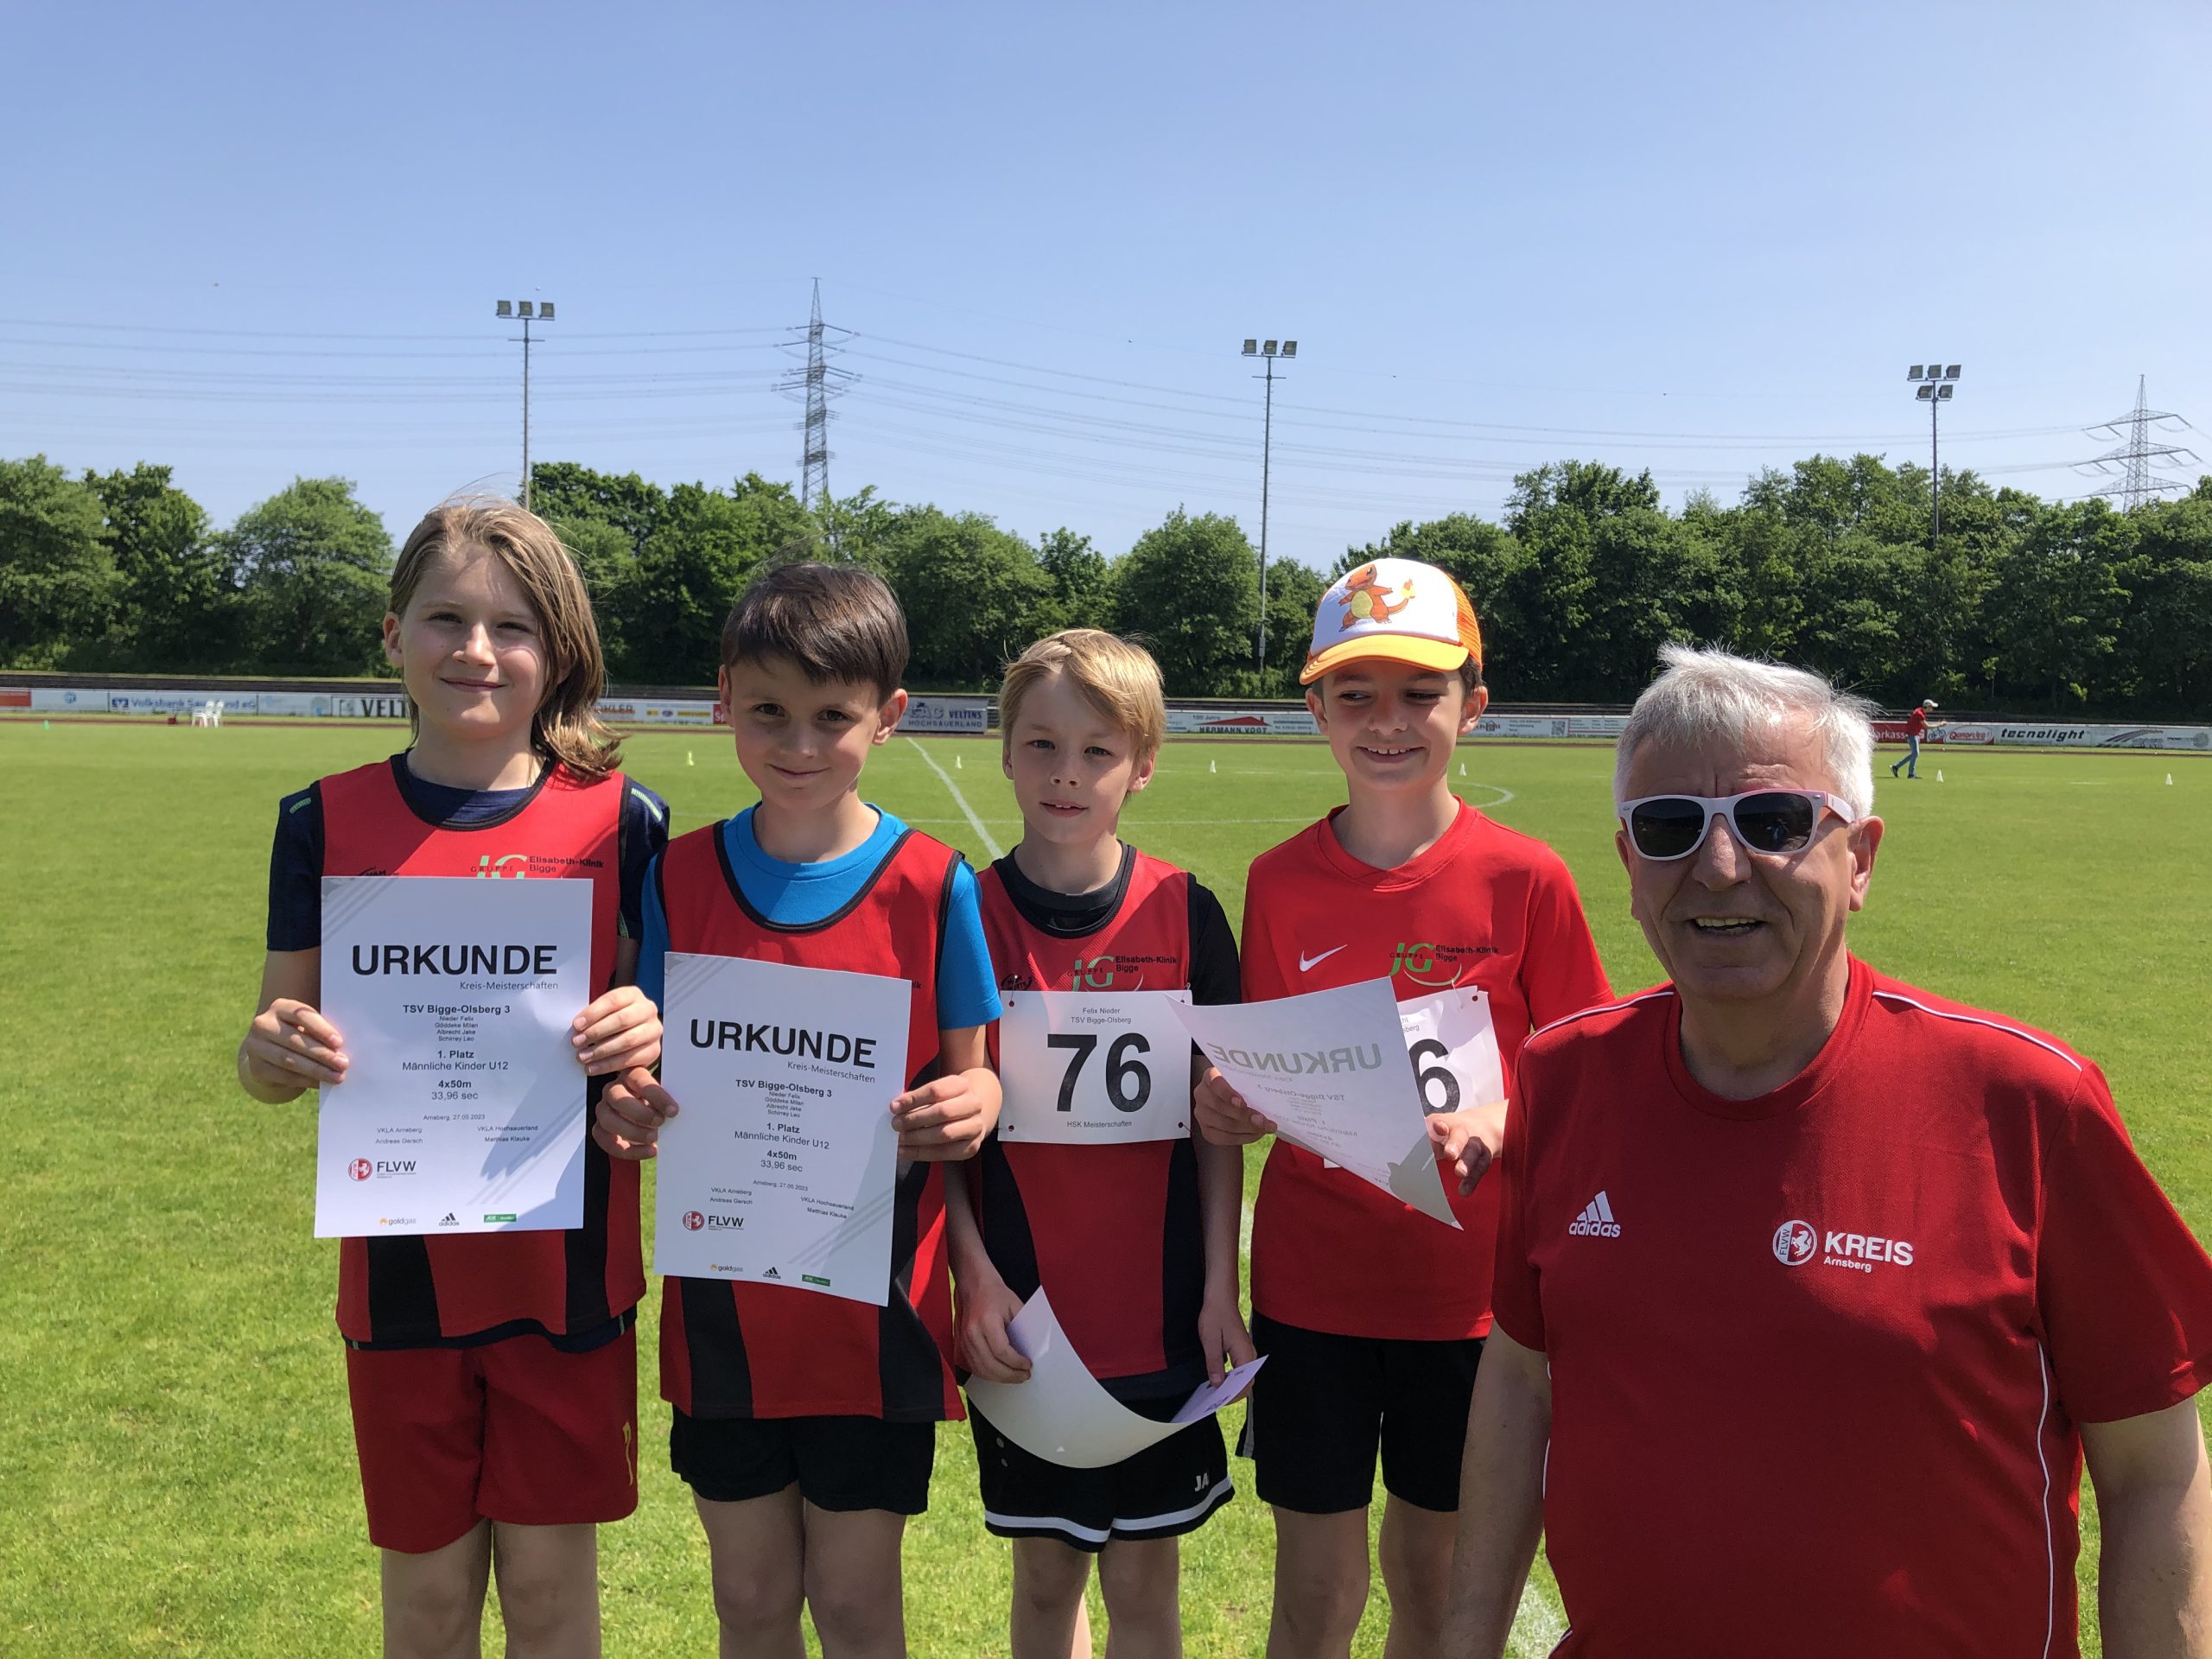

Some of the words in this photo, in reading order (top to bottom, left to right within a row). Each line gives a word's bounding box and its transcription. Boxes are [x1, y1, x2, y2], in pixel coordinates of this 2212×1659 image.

[949, 710, 982, 720] VELTINS
[908, 720, 982, 728] HOCHSAUERLAND
[2000, 728, 2085, 742] tecnolight
[529, 855, 604, 868] Elisabeth-Klinik
[529, 864, 557, 873] Bigge
[1435, 945, 1499, 955] Elisabeth-Klinik
[352, 944, 557, 976] URKUNDE
[1115, 956, 1177, 964] Elisabeth-Klinik
[1435, 953, 1458, 963] Bigge
[1116, 963, 1140, 973] Bigge
[460, 981, 559, 990] Kreis-Meisterschaften
[403, 1004, 424, 1014] TSV
[427, 1004, 501, 1015] Bigge-Olsberg
[504, 1004, 511, 1014] 3
[1086, 1016, 1132, 1026] Bigge-Olsberg
[690, 1019, 877, 1069] URKUNDE
[437, 1050, 447, 1058] 1.
[449, 1050, 474, 1058] Platz
[403, 1062, 452, 1071] Männliche
[454, 1061, 486, 1071] Kinder
[489, 1061, 509, 1071] U12
[787, 1061, 876, 1084] Kreis-Meisterschaften
[1047, 1033, 1152, 1113] 76
[1408, 1039, 1460, 1117] 6
[438, 1080, 472, 1089] 4x50m
[735, 1079, 756, 1088] TSV
[758, 1080, 824, 1098] Bigge-Olsberg
[826, 1089, 832, 1097] 3
[431, 1091, 459, 1101] 33,96
[778, 1123, 800, 1134] Platz
[734, 1131, 779, 1141] Männliche
[782, 1135, 810, 1146] Kinder
[812, 1139, 830, 1149] U12
[766, 1150, 797, 1160] 4x50m
[377, 1160, 416, 1173] FLVW
[760, 1160, 785, 1171] 33,96
[787, 1163, 803, 1173] sec
[388, 1217, 416, 1226] goldgas
[708, 1215, 744, 1228] FLVW
[1568, 1220, 1621, 1237] adidas
[1779, 1229, 1790, 1255] FLVW
[1824, 1230, 1914, 1266] KREIS
[717, 1264, 743, 1273] goldgas
[1823, 1255, 1872, 1274] Arnsberg
